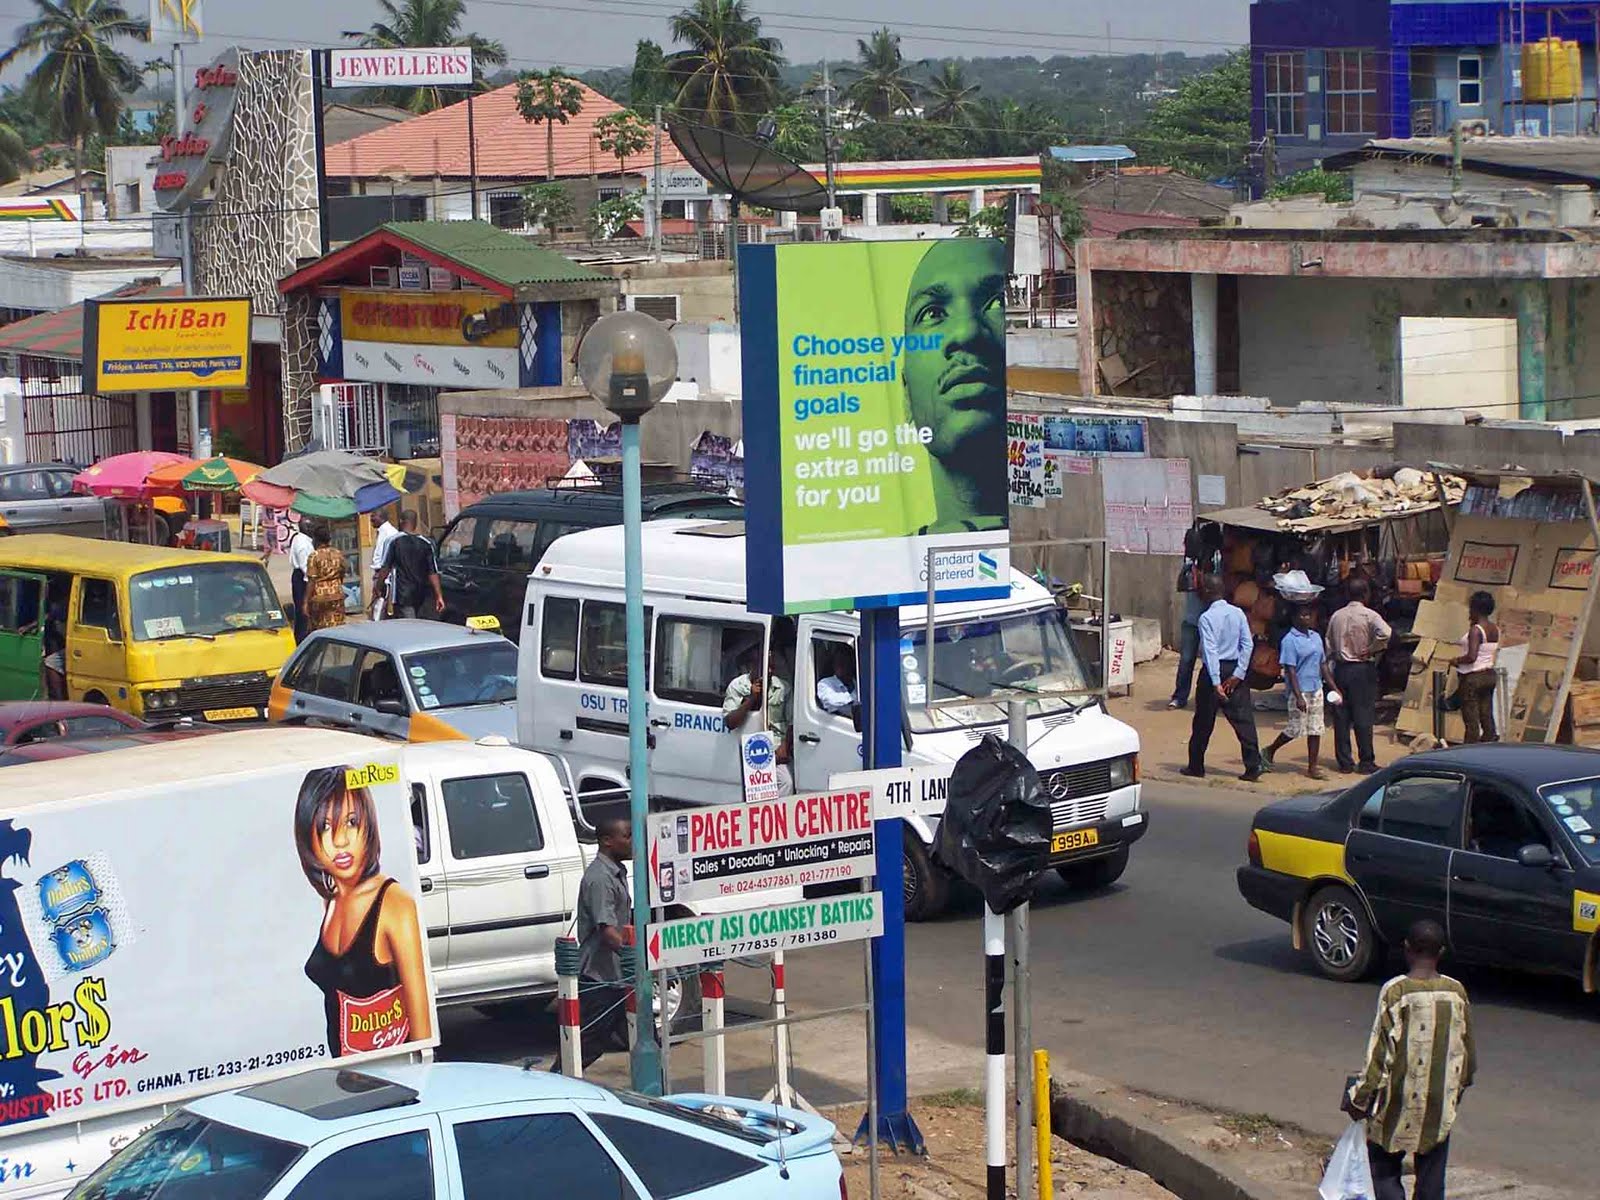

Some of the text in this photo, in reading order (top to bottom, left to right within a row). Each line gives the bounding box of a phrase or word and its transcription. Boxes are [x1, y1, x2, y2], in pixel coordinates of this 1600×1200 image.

[336, 55, 468, 77] JEWELLERS
[126, 306, 227, 331] IchiBan
[793, 333, 945, 357] Choose your
[793, 360, 896, 386] financial
[794, 392, 861, 421] goals
[794, 421, 934, 452] we'll go the
[795, 452, 916, 479] extra mile
[795, 485, 881, 509] for you
[923, 552, 974, 567] Sandard
[919, 566, 974, 582] Cartered
[581, 693, 606, 711] OSU
[349, 765, 395, 786] AFRUS
[886, 781, 911, 804] 4TH
[691, 791, 872, 853] PAGE FON CENTRE
[694, 838, 872, 875] Sales Decoding Unlocking Repairs
[720, 883, 735, 894] Tel:
[662, 897, 874, 950] MERCY ASI OCANSEY BATIKS
[702, 946, 726, 958] TEL:
[731, 938, 778, 955] 777835
[790, 930, 837, 945] 781380
[0, 976, 111, 1060] lor$
[72, 1043, 149, 1080] Gin
[94, 1078, 131, 1101] LTD.
[137, 1073, 186, 1093] GHANA.
[188, 1067, 215, 1084] TEL:
[217, 1043, 326, 1077] 233-21-239082-3
